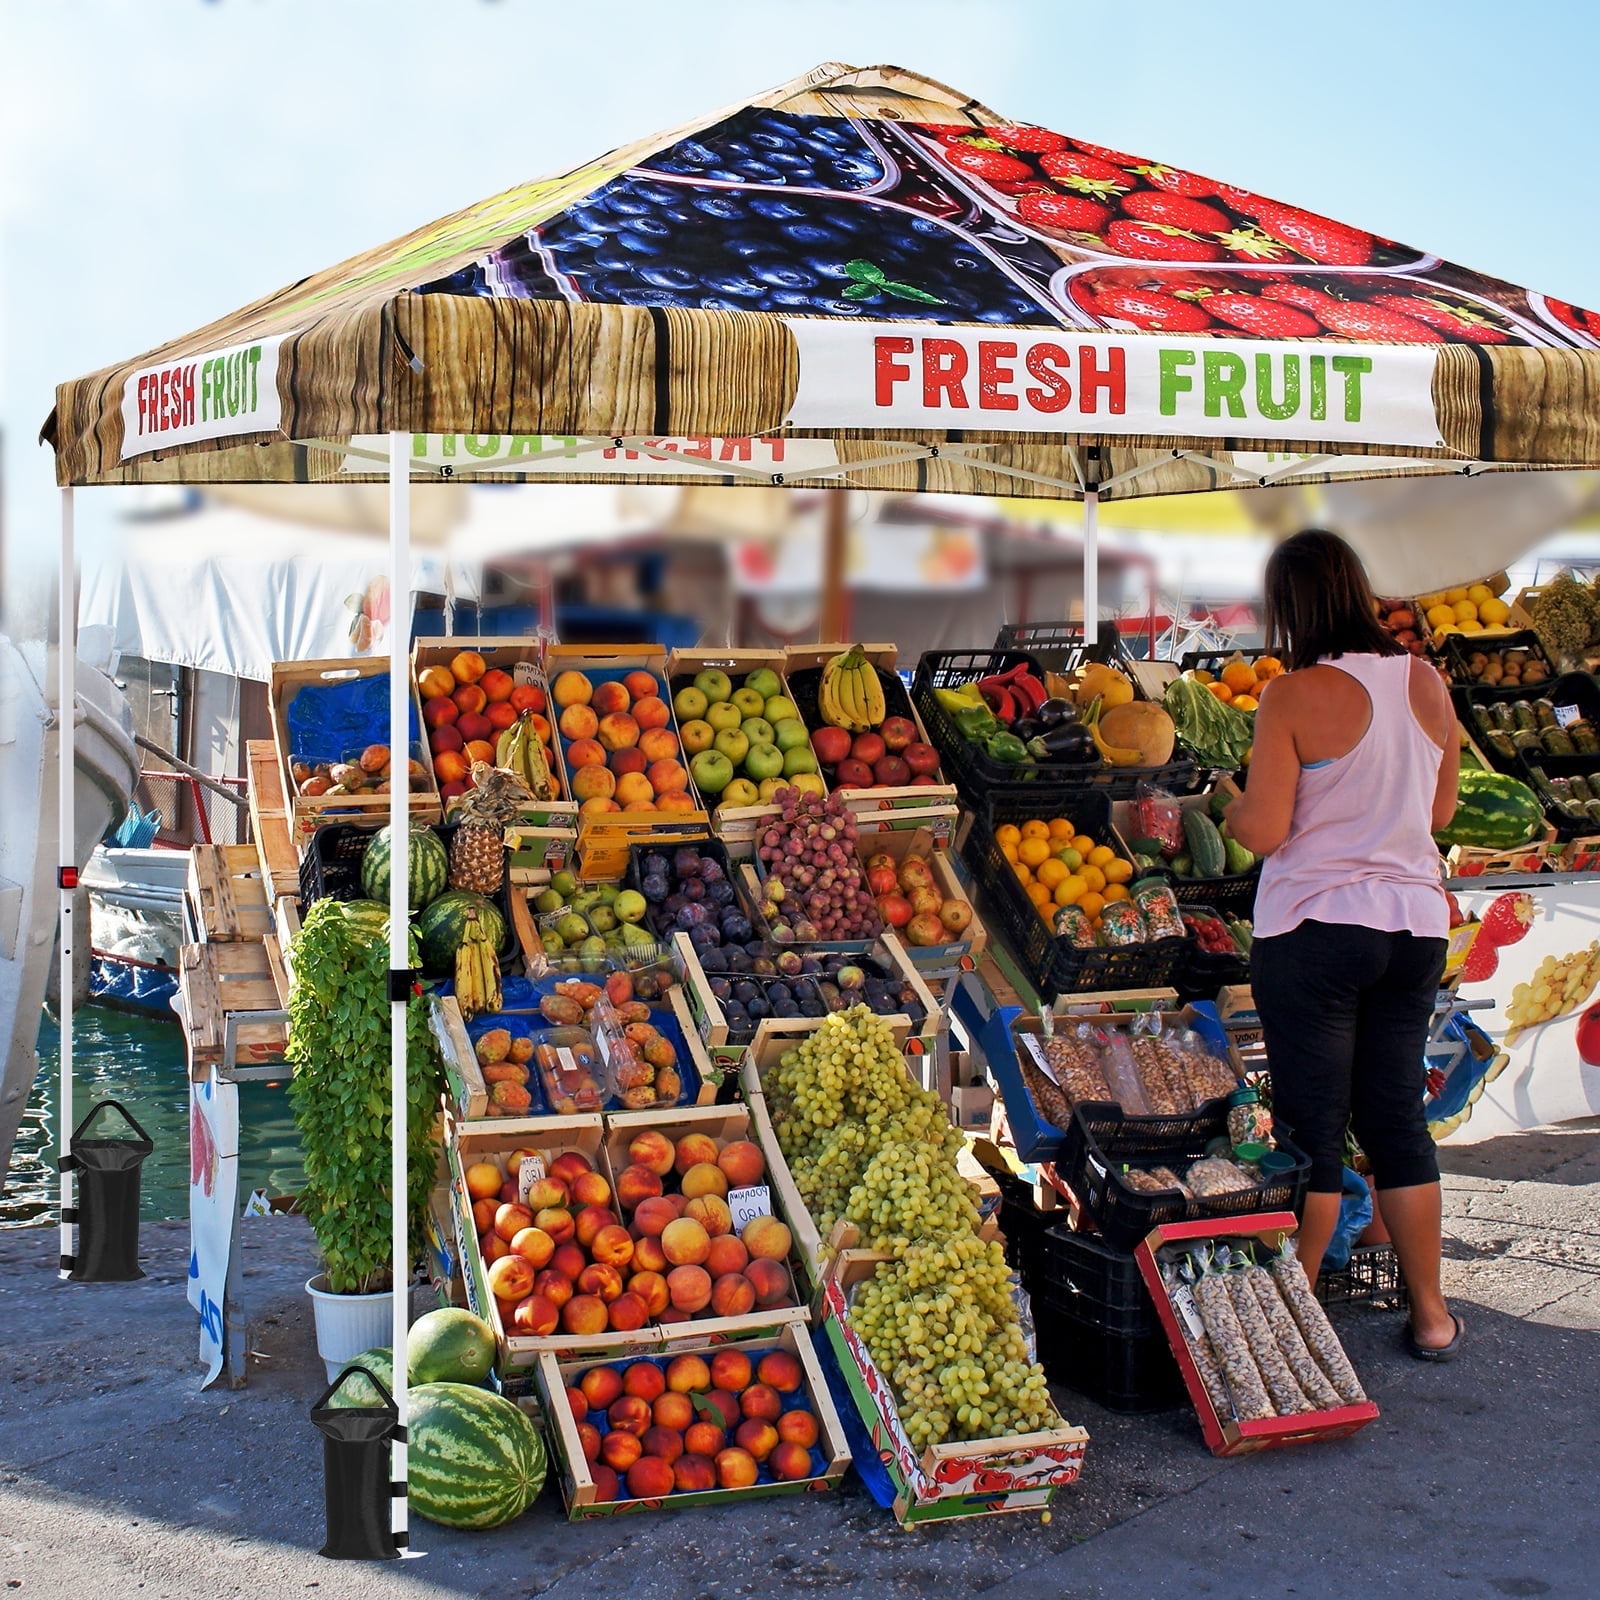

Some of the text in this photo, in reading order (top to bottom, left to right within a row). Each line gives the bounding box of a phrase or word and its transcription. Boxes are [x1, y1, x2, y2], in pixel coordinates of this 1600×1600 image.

[138, 345, 262, 436] FRESH FRUIT
[874, 336, 1373, 423] FRESH FRUIT
